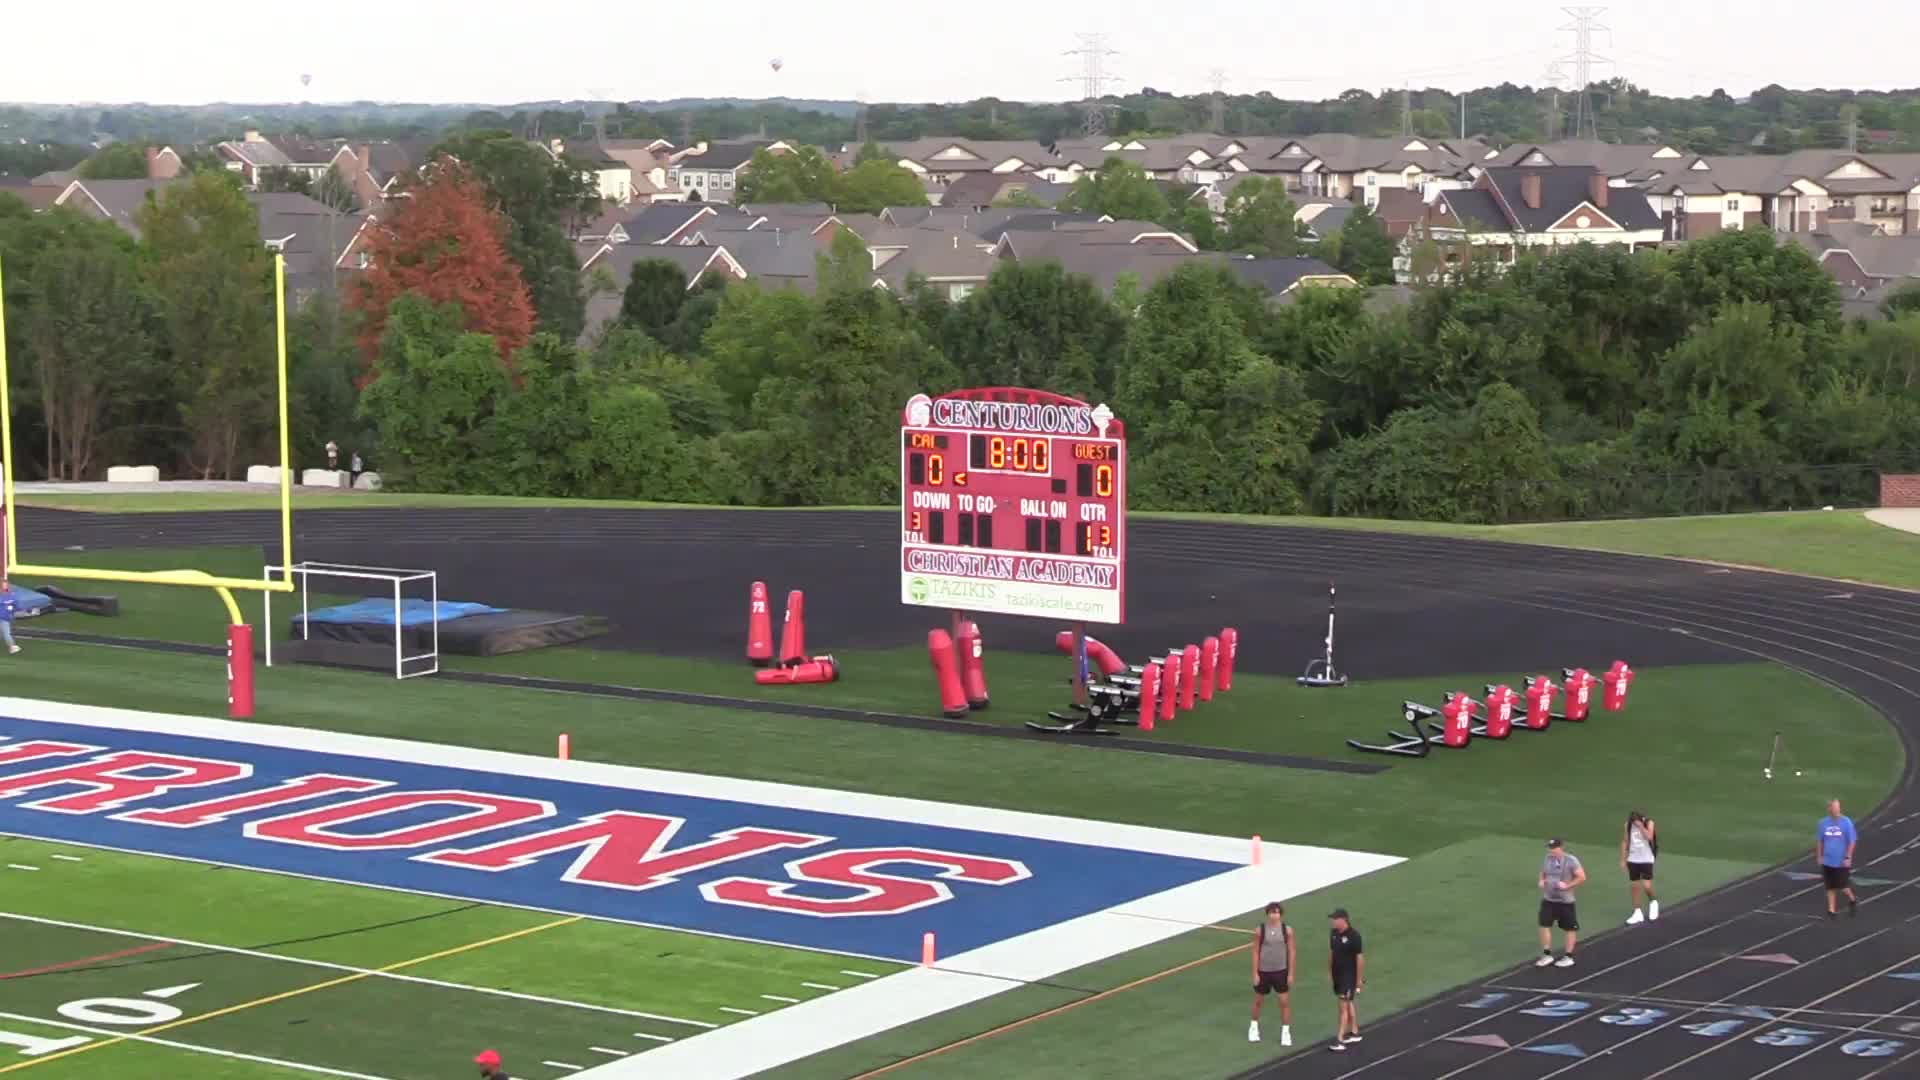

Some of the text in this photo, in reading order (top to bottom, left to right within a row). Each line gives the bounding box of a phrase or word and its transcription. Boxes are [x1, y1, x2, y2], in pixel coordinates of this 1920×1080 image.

[932, 398, 1092, 434] CENTURIONS
[990, 436, 1048, 471] 8:00
[1075, 443, 1112, 460] GUEST
[928, 454, 943, 484] 0
[1097, 464, 1112, 497] 0
[913, 491, 951, 511] DOWN
[957, 494, 974, 512] TO
[1020, 498, 1067, 519] BALL ON
[912, 511, 921, 530] 3
[1080, 503, 1106, 522] QTR
[1101, 525, 1111, 545] 3
[908, 549, 1114, 588] CHRISTIAN ACADEMY
[1519, 999, 1592, 1017] 2
